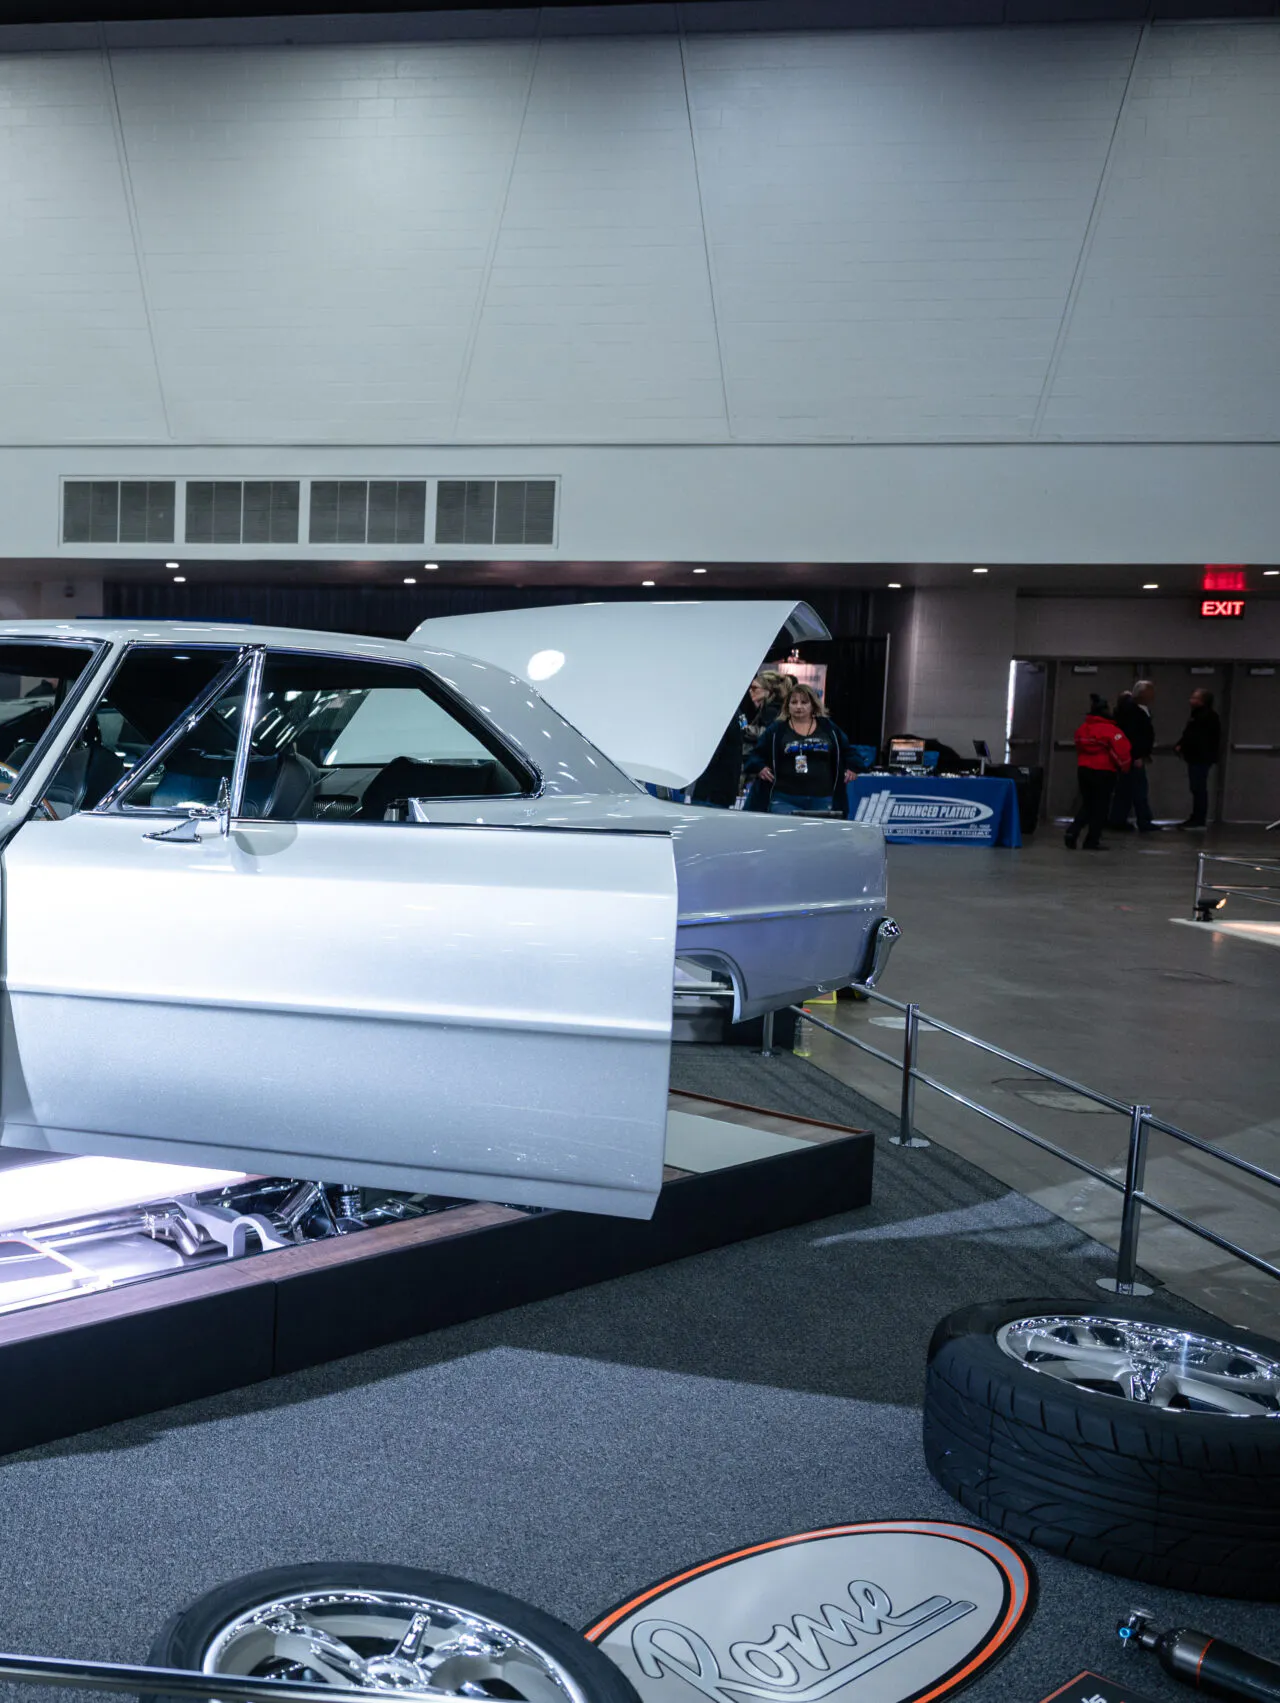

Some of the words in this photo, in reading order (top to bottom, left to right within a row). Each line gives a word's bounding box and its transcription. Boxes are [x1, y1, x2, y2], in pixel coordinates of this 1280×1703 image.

[1201, 600, 1245, 616] EXIT
[891, 804, 938, 818] ADVANCED
[939, 805, 978, 819] PLATING
[632, 1579, 977, 1703] Rome
